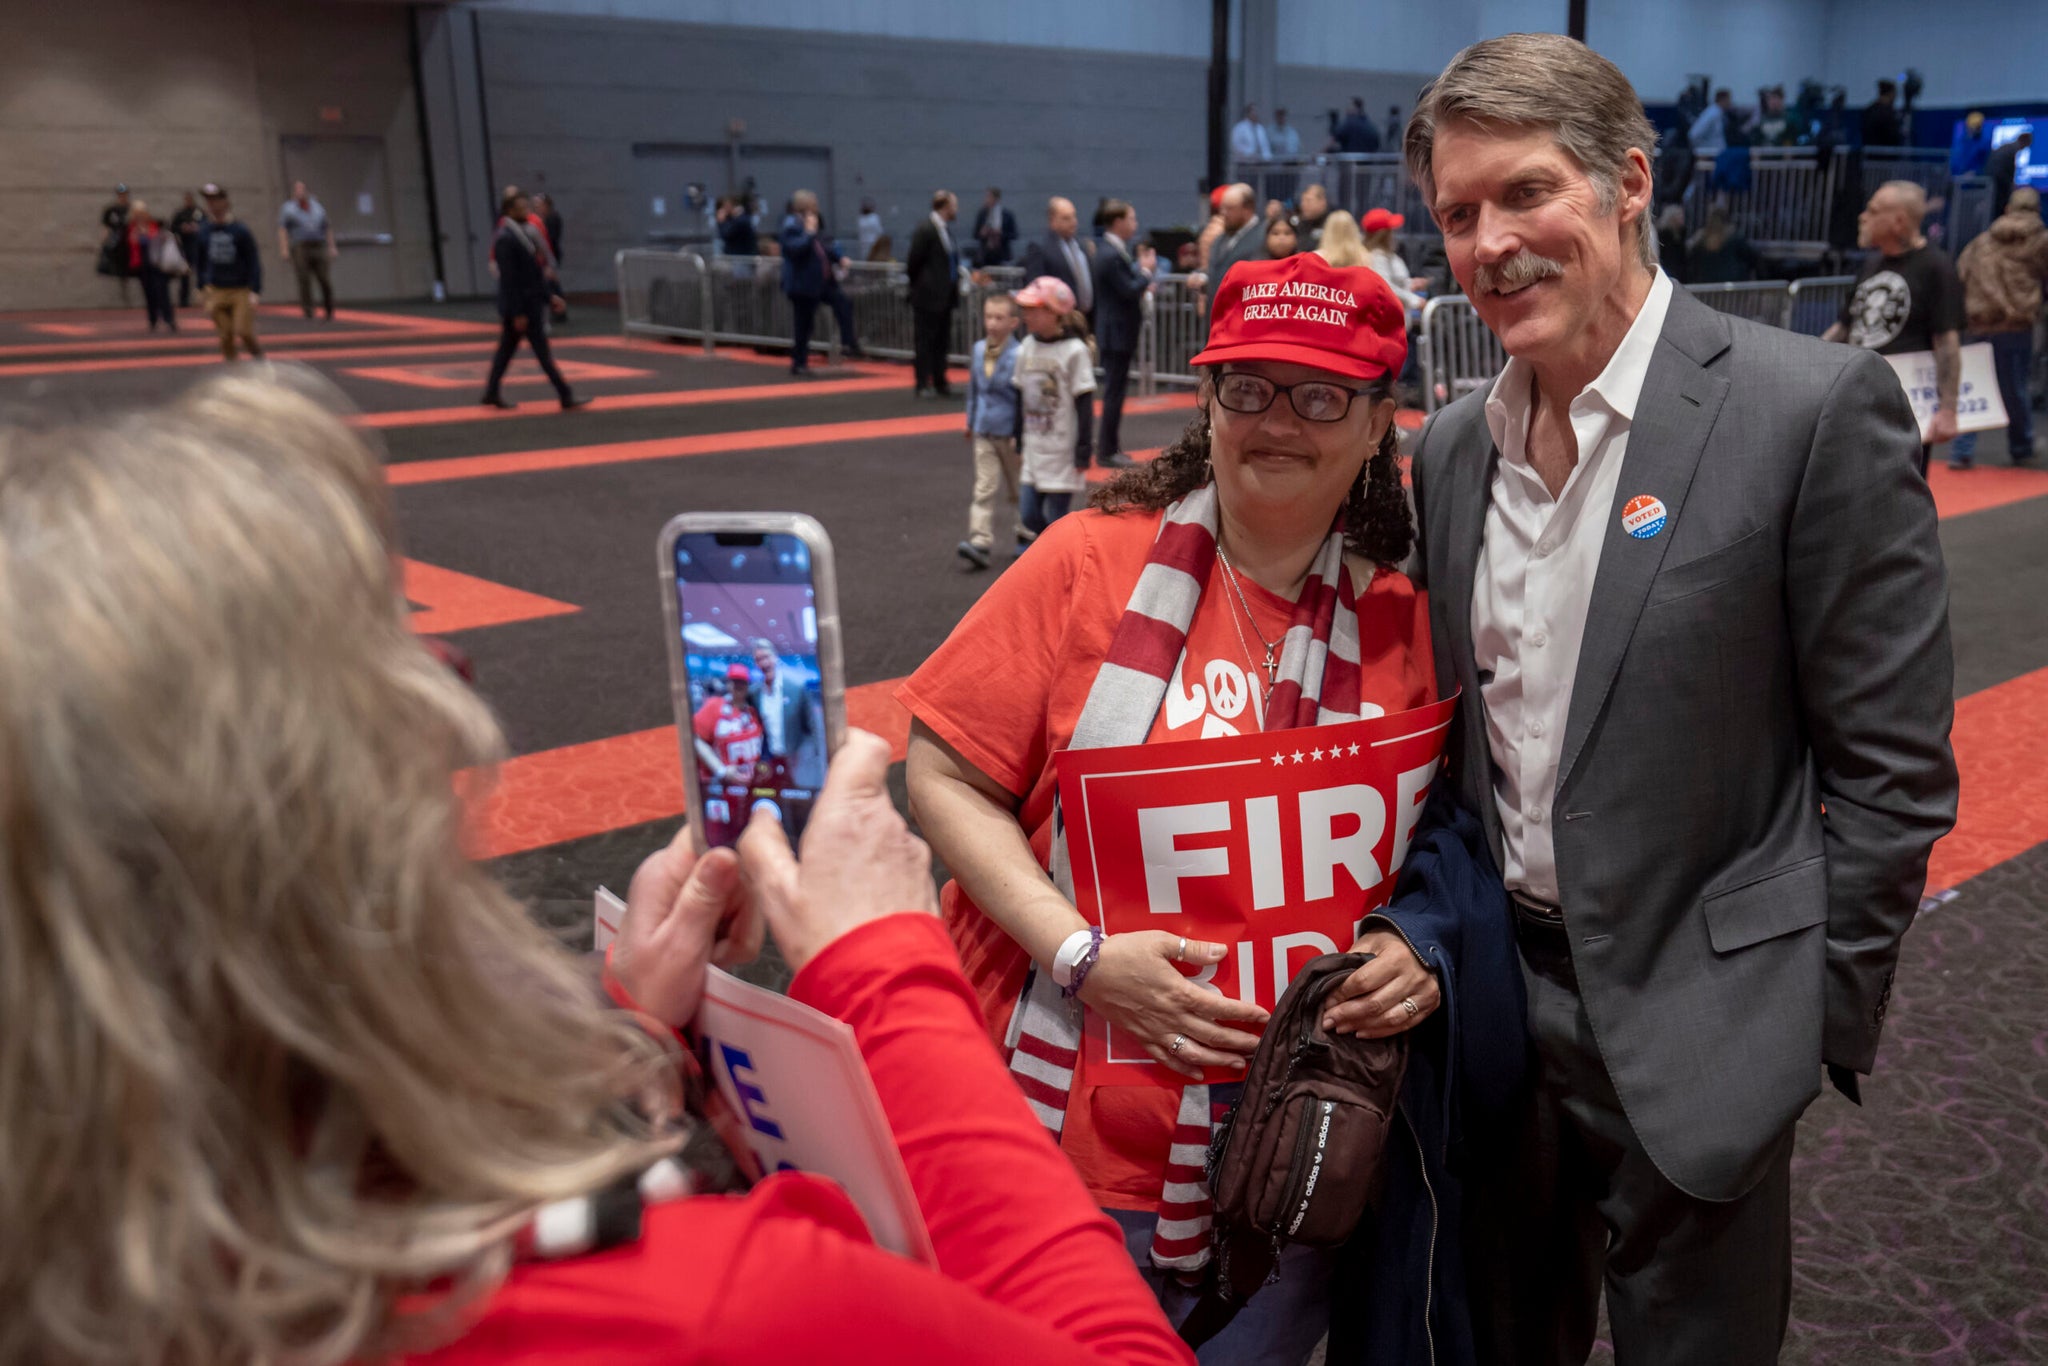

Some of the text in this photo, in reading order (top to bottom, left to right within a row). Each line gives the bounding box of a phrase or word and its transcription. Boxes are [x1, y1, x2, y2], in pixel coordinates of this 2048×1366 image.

[1242, 281, 1358, 308] MAKE AMERICA
[1243, 304, 1348, 327] GREAT AGAIN
[1635, 500, 1643, 509] I
[1628, 507, 1661, 526] VOTED
[1637, 520, 1661, 535] TODAY
[1318, 1115, 1331, 1148] adidas
[1305, 1165, 1320, 1196] adidas
[1287, 1211, 1305, 1235] adidas
